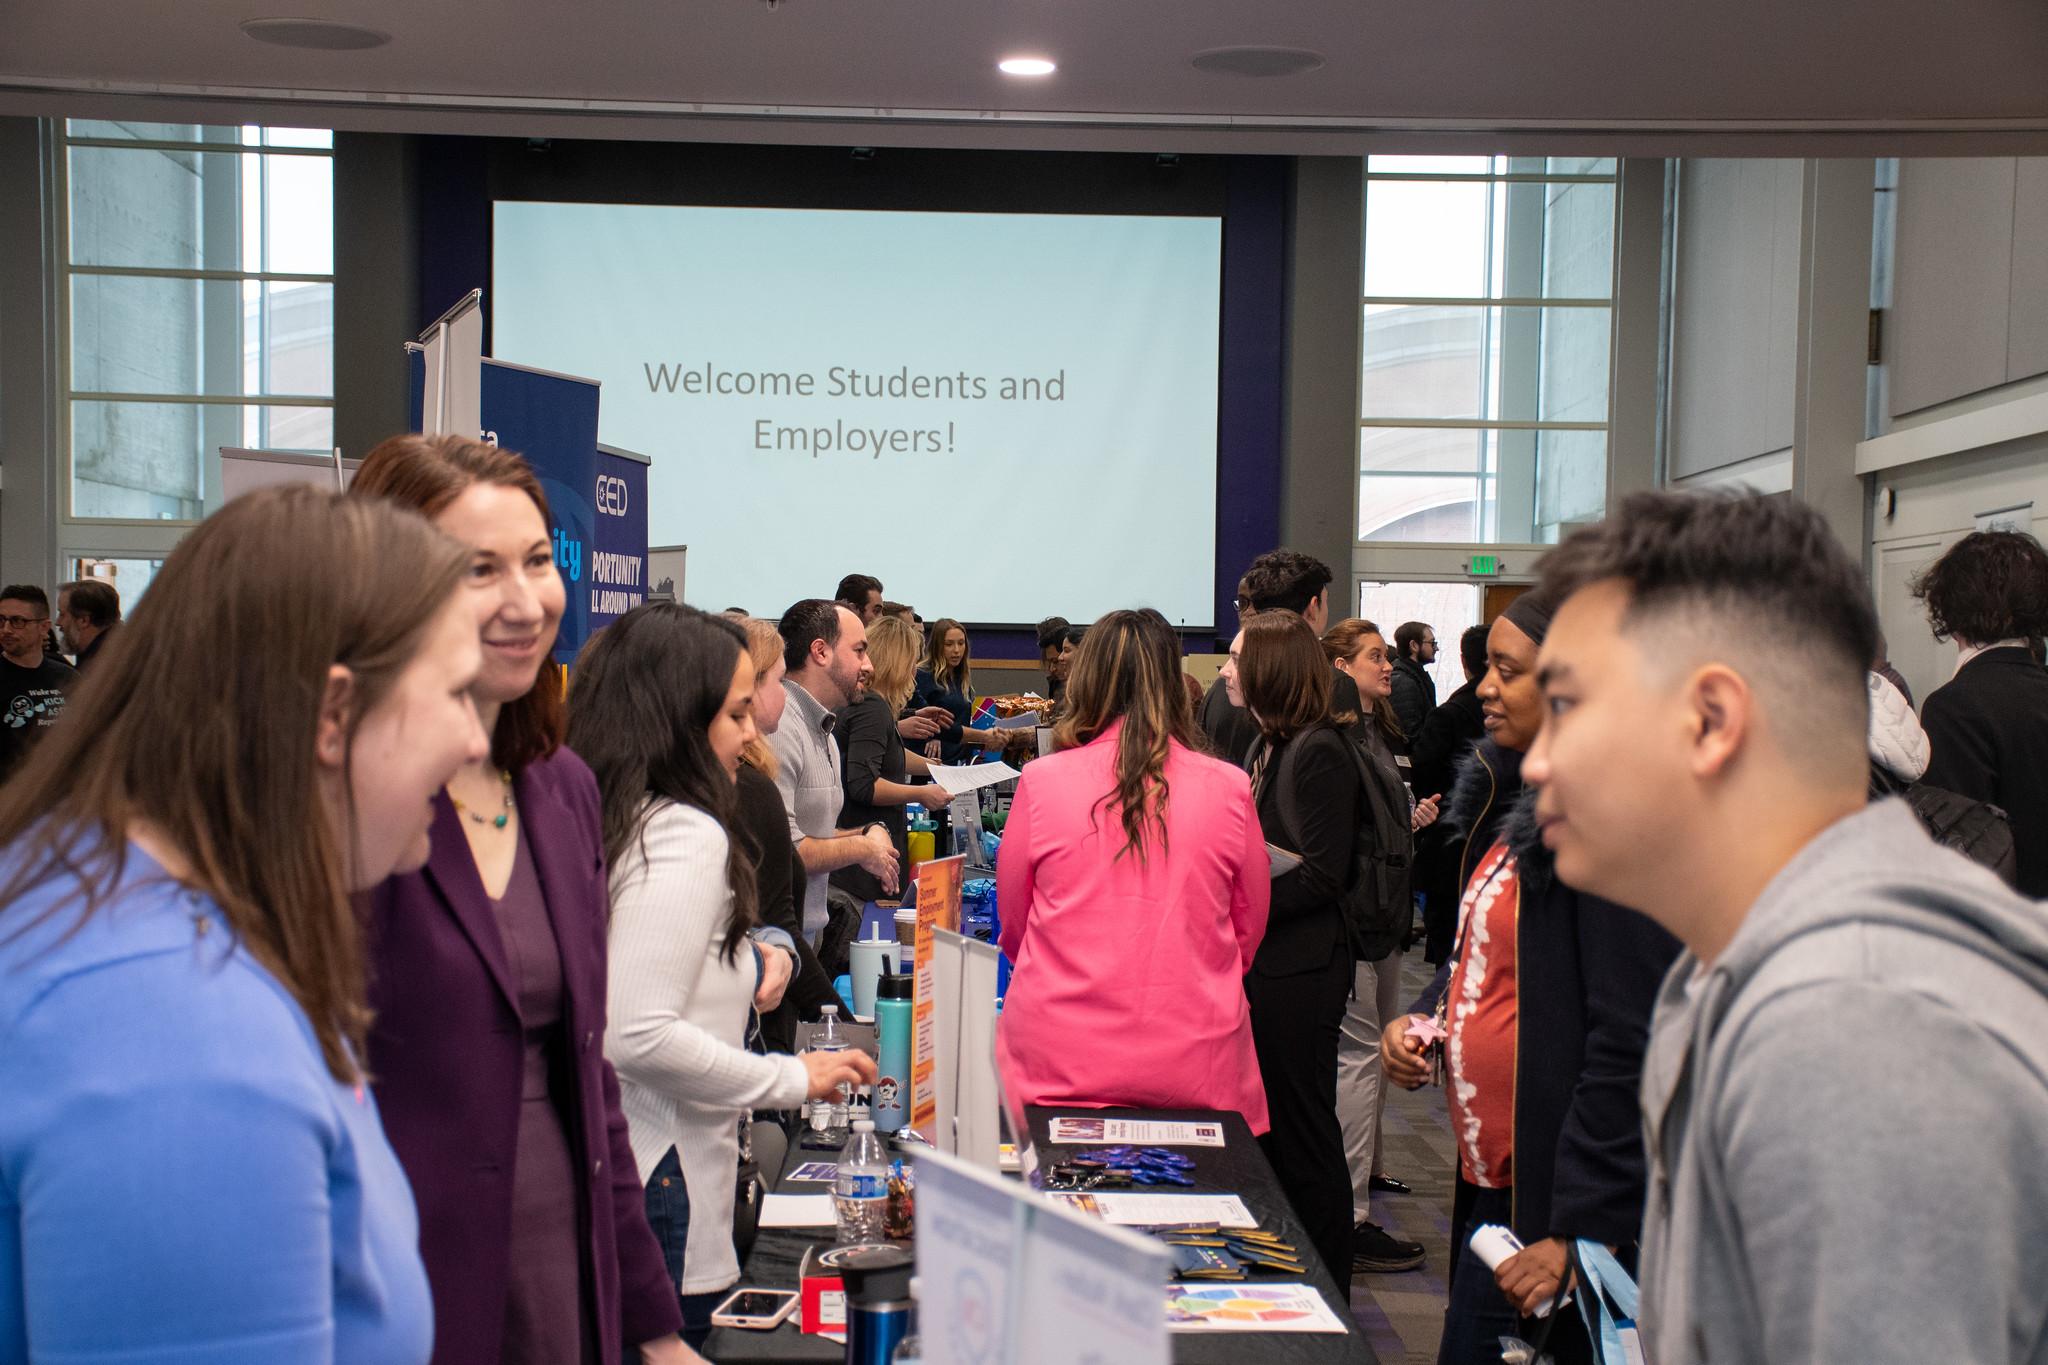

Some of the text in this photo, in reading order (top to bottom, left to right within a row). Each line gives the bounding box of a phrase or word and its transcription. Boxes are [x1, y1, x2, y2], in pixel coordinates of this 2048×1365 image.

[643, 361, 1066, 401] Welcome Students and
[754, 418, 955, 459] Employers!
[552, 527, 582, 582] ity
[592, 551, 642, 587] PORTUNITY
[1472, 555, 1496, 575] EXIT
[591, 589, 600, 613] LL
[601, 590, 628, 615] AROUND
